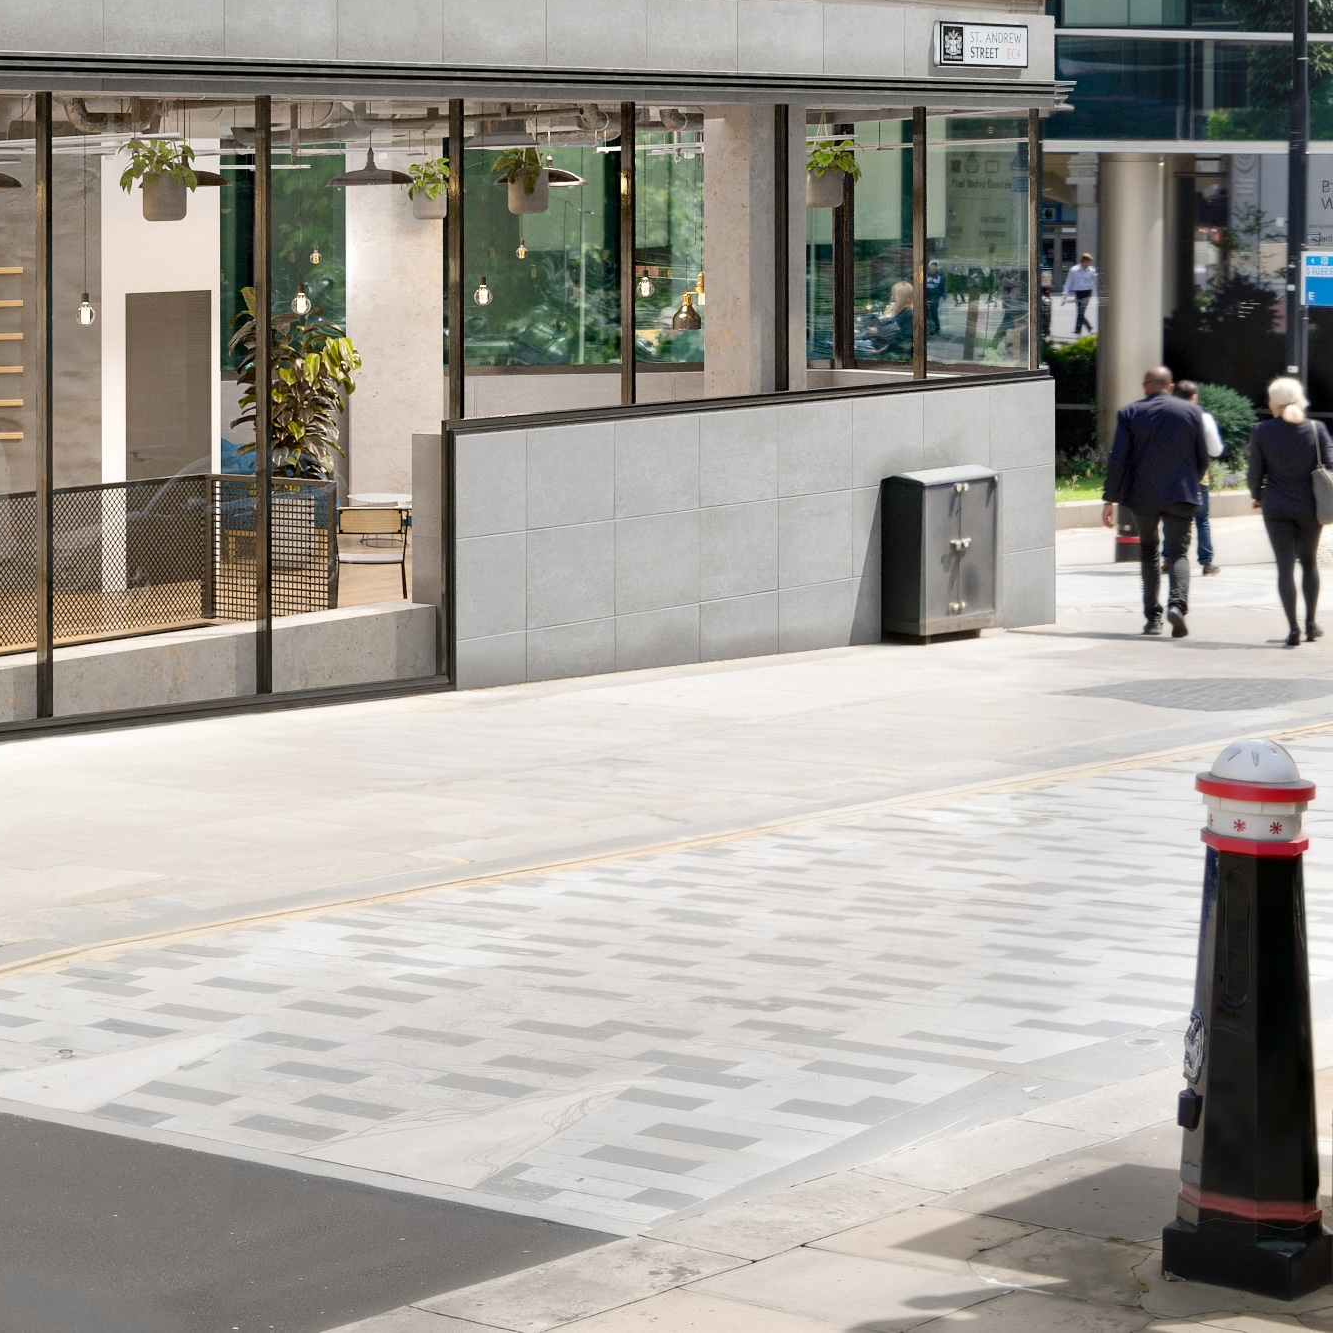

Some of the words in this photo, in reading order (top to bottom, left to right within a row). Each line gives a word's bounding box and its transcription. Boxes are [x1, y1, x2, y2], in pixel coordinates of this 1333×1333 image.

[970, 31, 982, 43] ST.
[985, 32, 1022, 44] ANDREW
[970, 46, 999, 59] STREET
[1007, 48, 1022, 60] EC4
